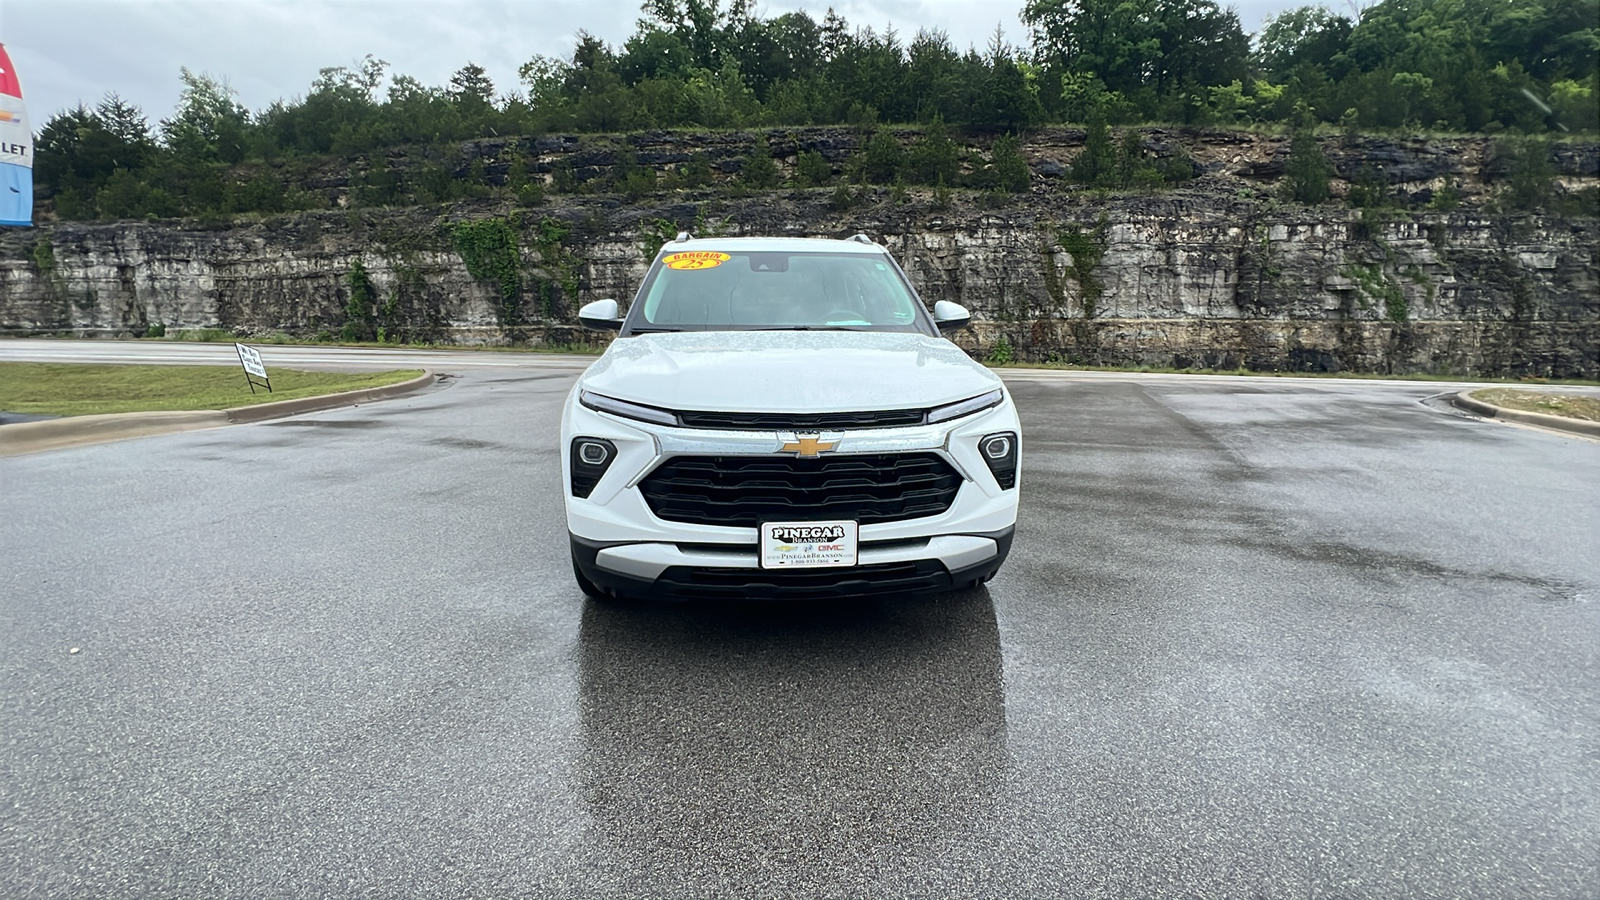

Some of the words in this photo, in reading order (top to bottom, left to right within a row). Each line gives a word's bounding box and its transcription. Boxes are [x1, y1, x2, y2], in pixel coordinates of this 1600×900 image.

[2, 142, 26, 156] LET
[674, 252, 722, 260] BARGAIN
[681, 259, 708, 268] 25
[772, 526, 845, 539] PINEGAR
